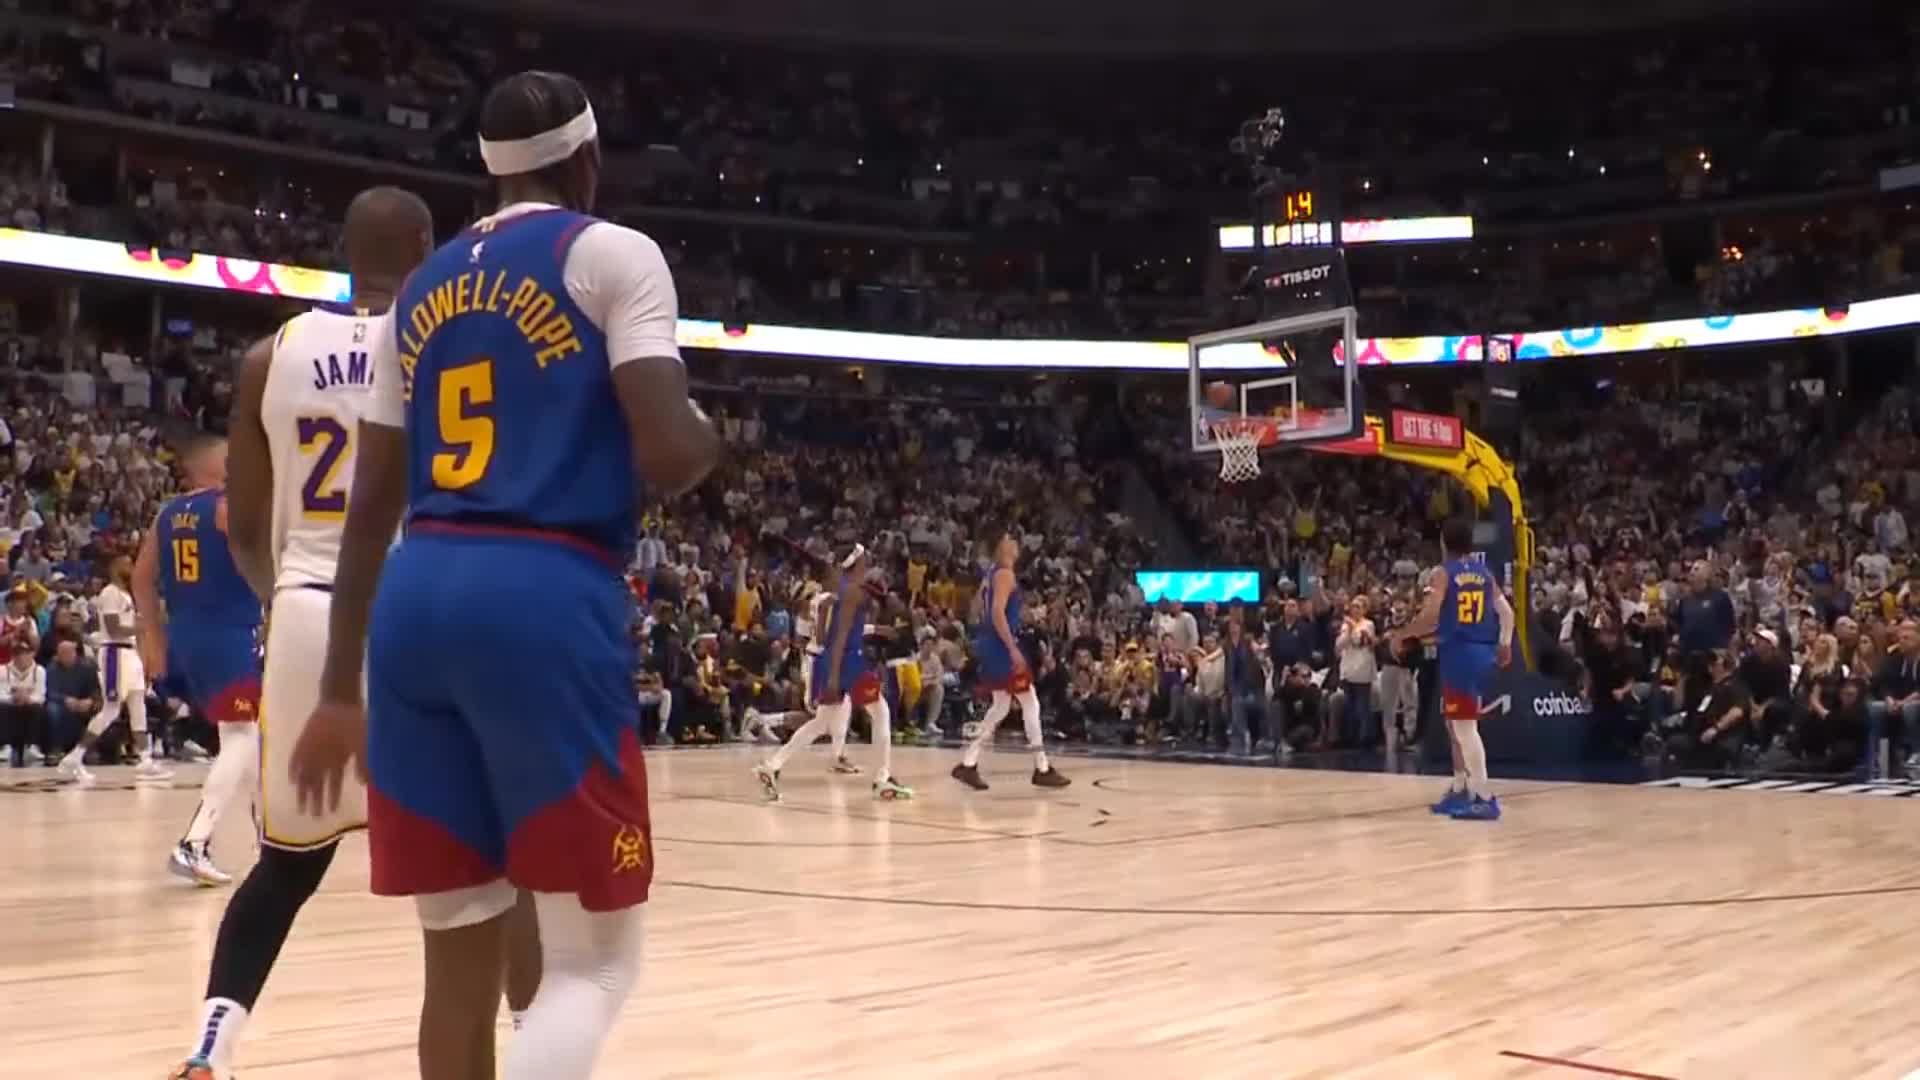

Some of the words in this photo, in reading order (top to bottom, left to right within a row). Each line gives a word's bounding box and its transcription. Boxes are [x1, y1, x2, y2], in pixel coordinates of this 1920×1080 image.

[1286, 191, 1313, 220] 1.4
[1281, 264, 1331, 287] TISSOT
[313, 351, 375, 391] JAM
[431, 359, 495, 491] 5
[296, 415, 348, 521] 2
[172, 538, 200, 583] 15
[1457, 590, 1485, 624] 27
[1533, 690, 1593, 716] coinba
